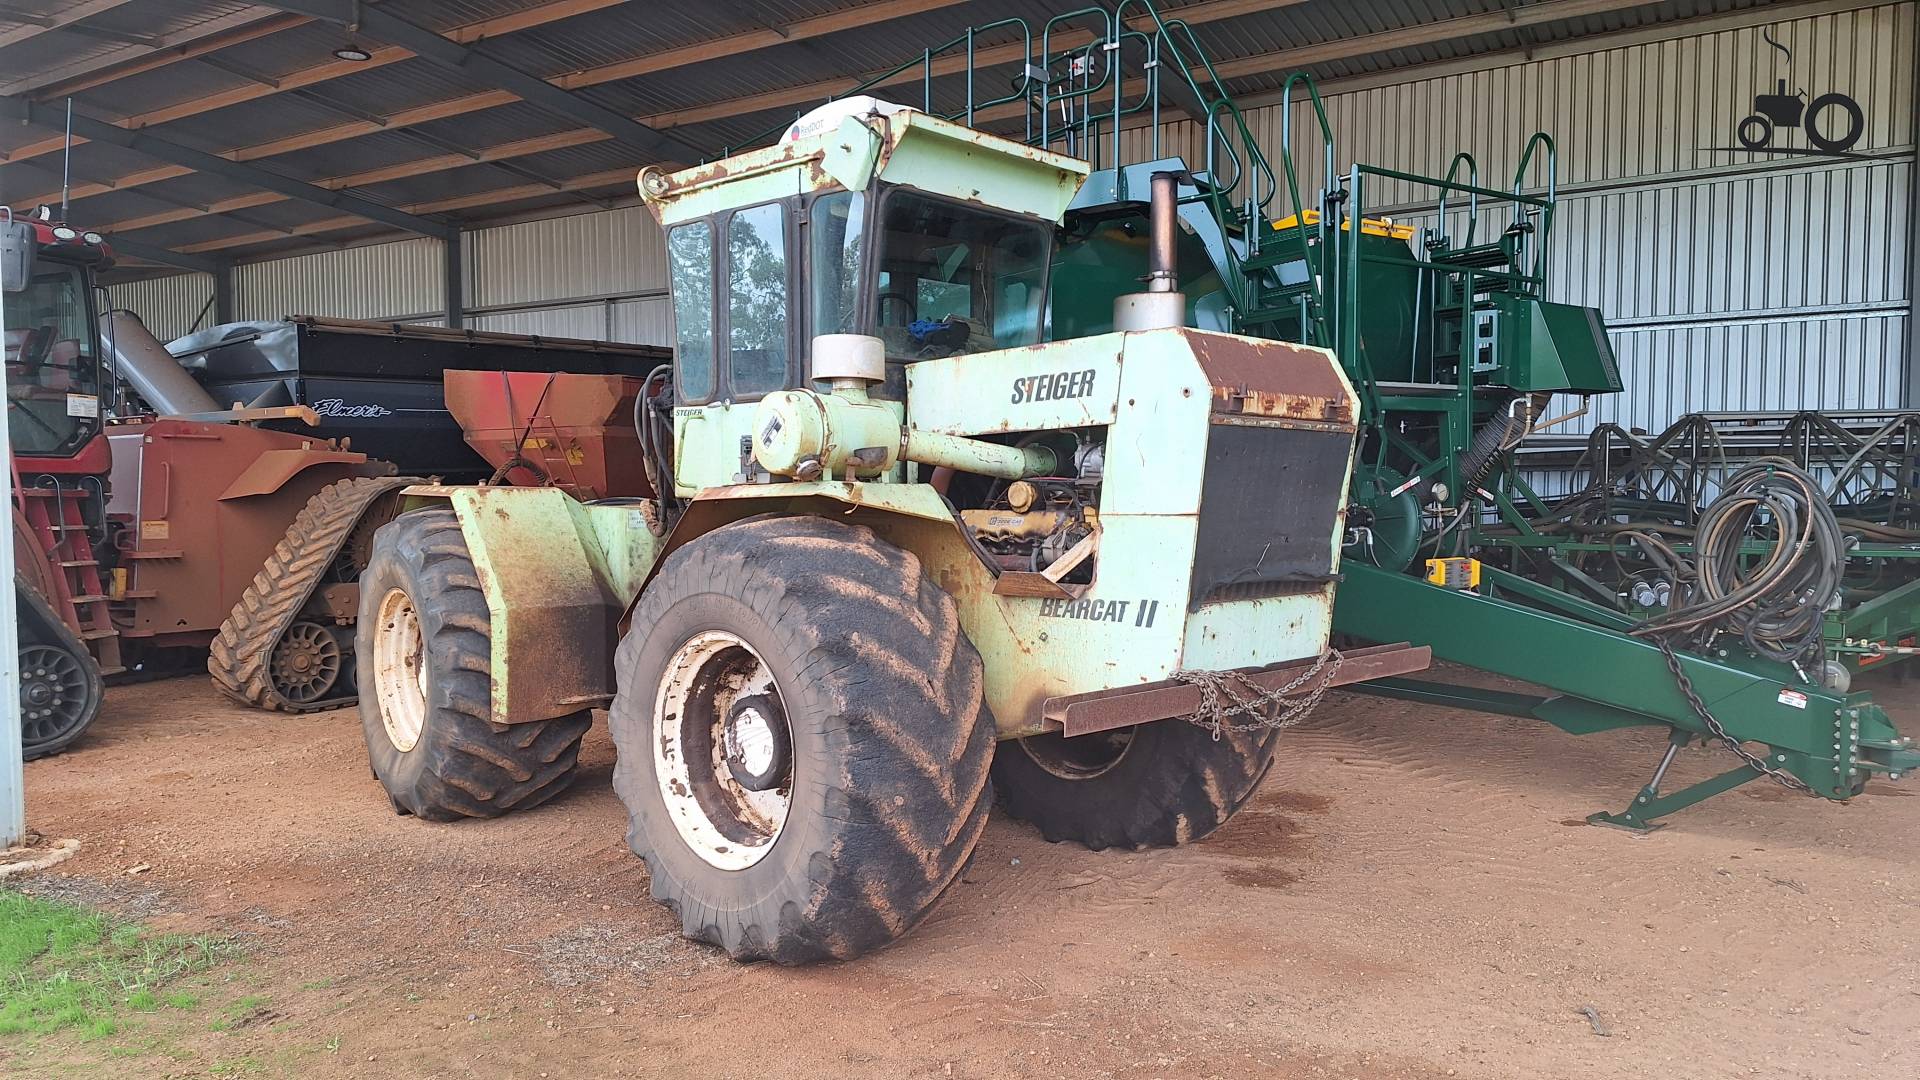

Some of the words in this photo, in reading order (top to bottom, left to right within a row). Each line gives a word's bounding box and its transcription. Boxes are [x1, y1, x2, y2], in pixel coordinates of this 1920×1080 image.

[1011, 369, 1096, 405] STEIGER
[312, 399, 391, 418] Elmer's
[675, 408, 703, 417] STEIGER
[1039, 598, 1130, 623] BEARCAT
[1135, 599, 1159, 628] II
